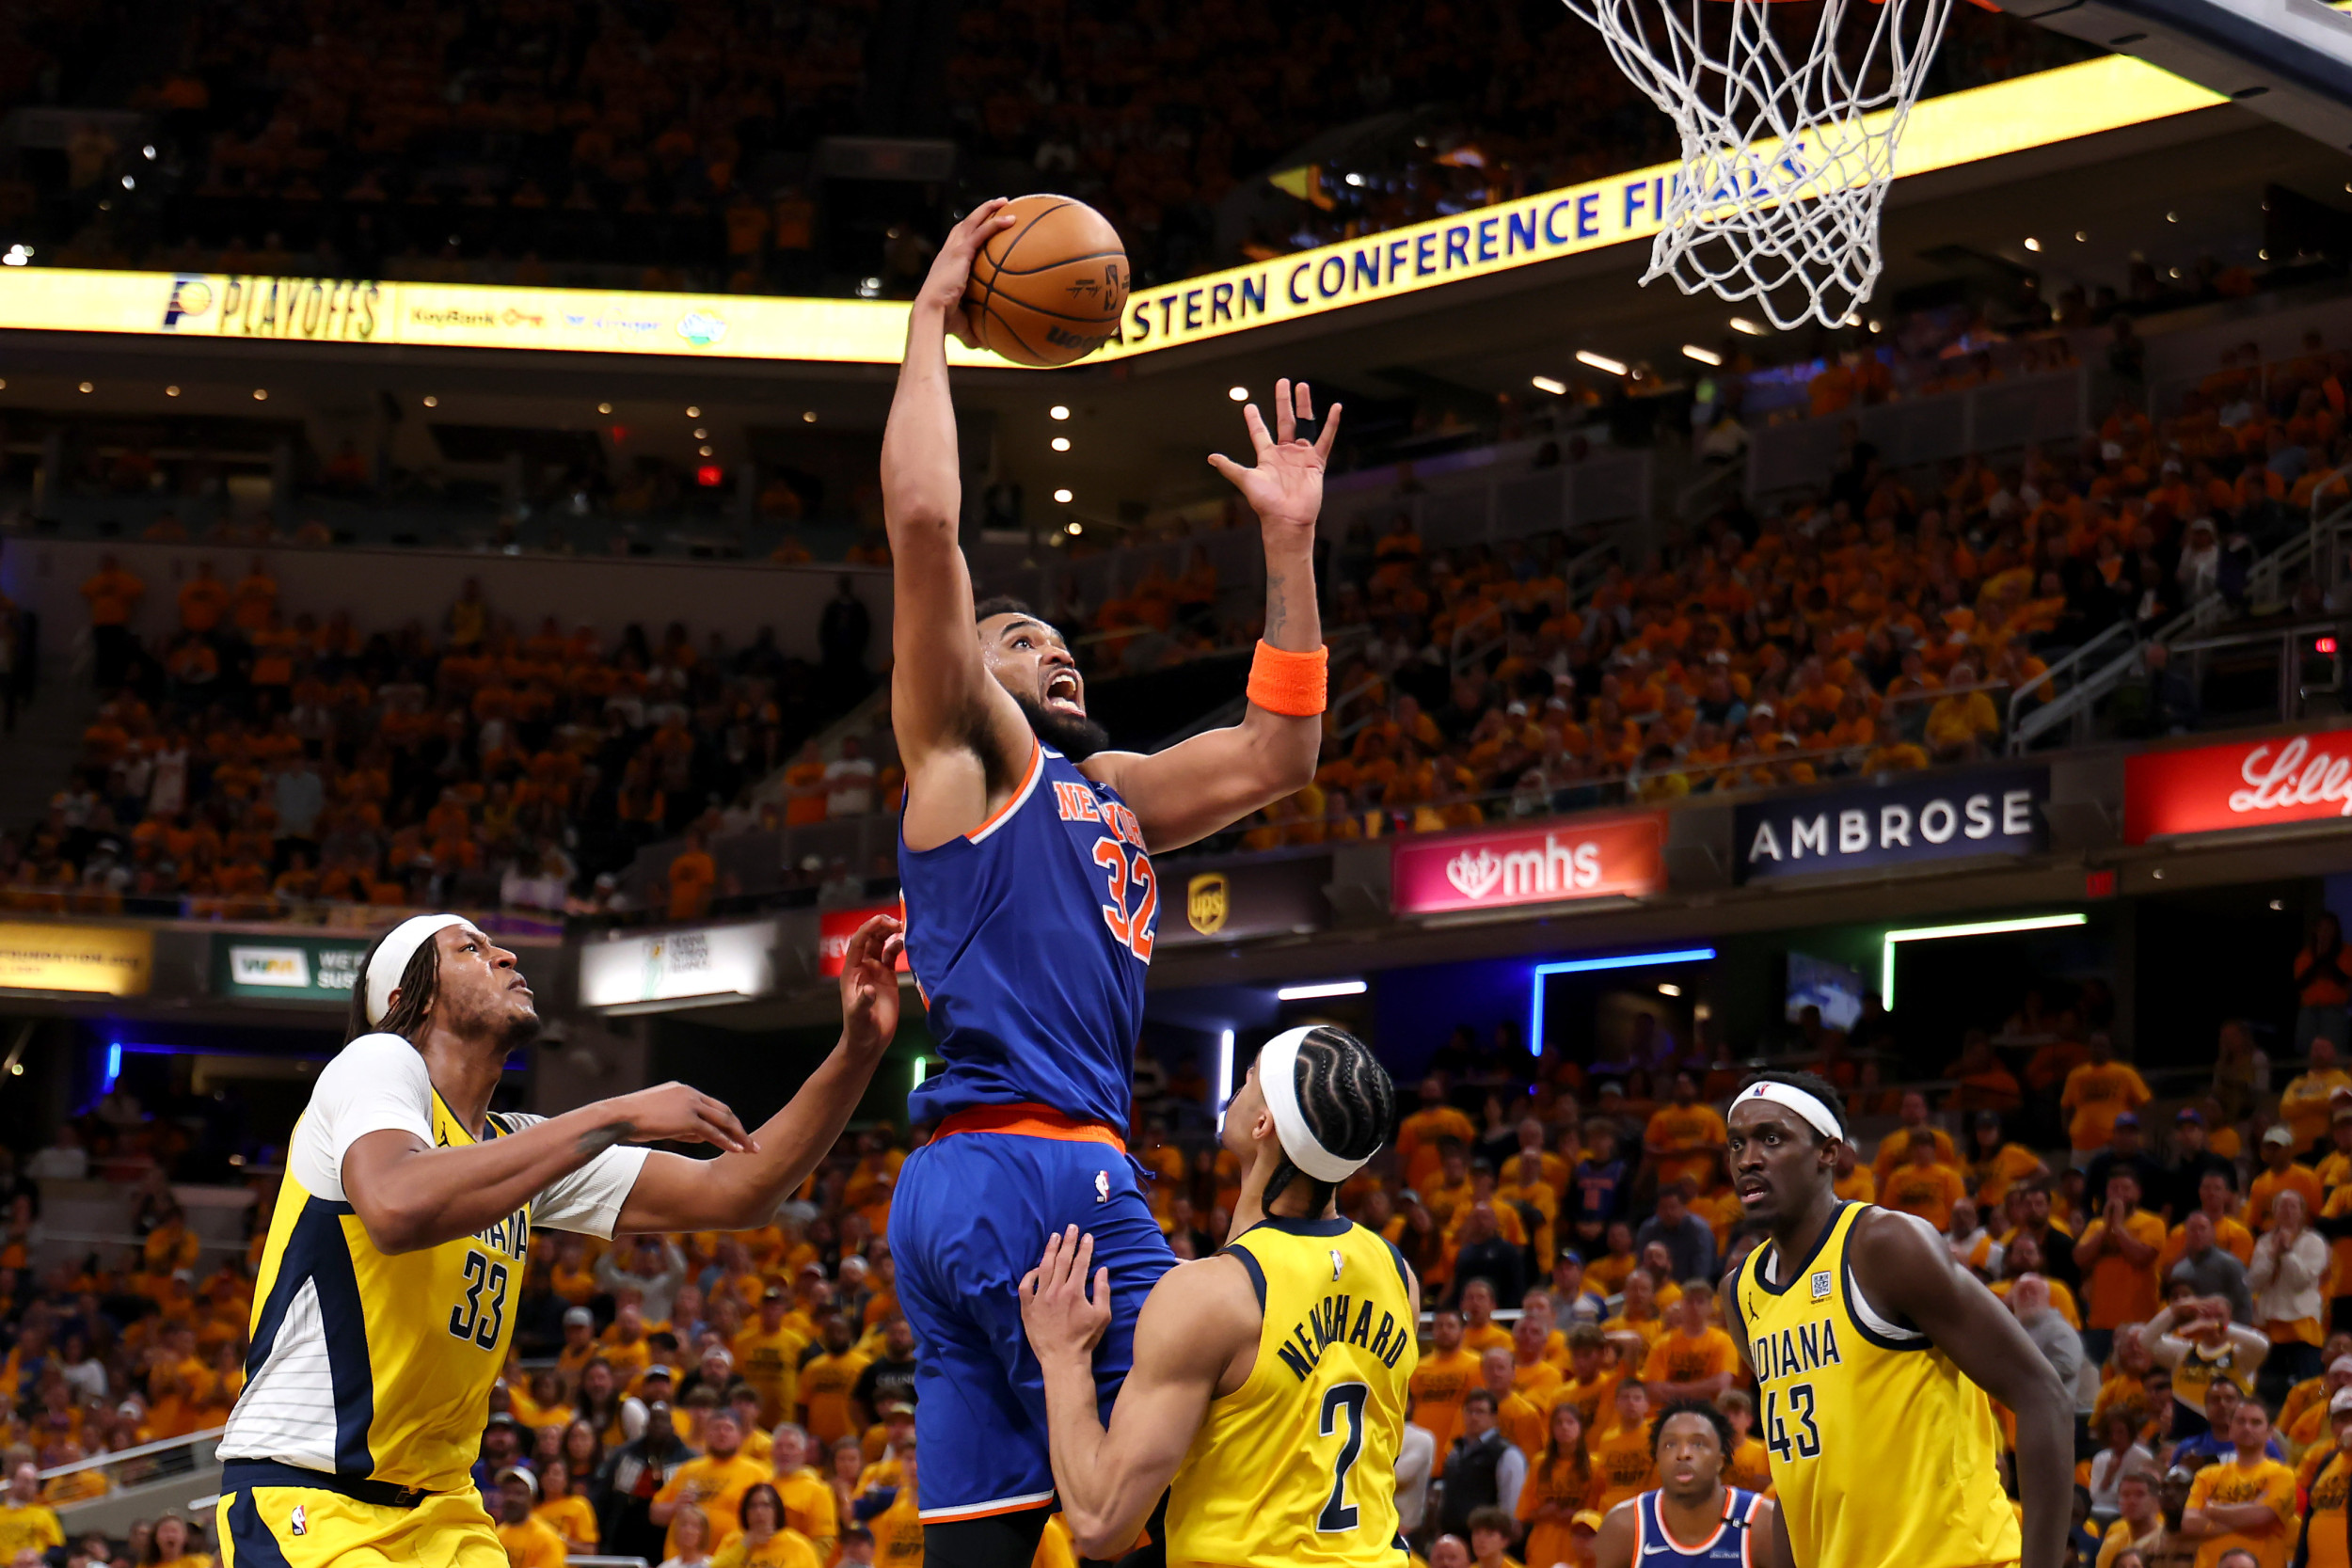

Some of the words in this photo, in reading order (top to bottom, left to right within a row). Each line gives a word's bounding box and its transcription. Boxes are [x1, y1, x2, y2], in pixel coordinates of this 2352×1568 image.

[1106, 274, 1267, 346] STERN
[1288, 192, 1600, 306] CONFERENCE
[1623, 142, 1806, 230] FILS
[220, 274, 383, 341] PLAYOFFS
[1052, 780, 1103, 824] NE
[1747, 788, 2033, 863] AMBROSE
[1502, 832, 1600, 895] mhs
[1091, 835, 1157, 966] 32
[1192, 896, 1221, 925] ups
[317, 969, 359, 990] SUS
[471, 1208, 528, 1265] IANA
[448, 1248, 508, 1353] 33
[1277, 1293, 1407, 1384] NEMBHARD
[1749, 1318, 1842, 1386] NDIANA
[1315, 1381, 1370, 1533] 2
[1766, 1382, 1821, 1465] 43
